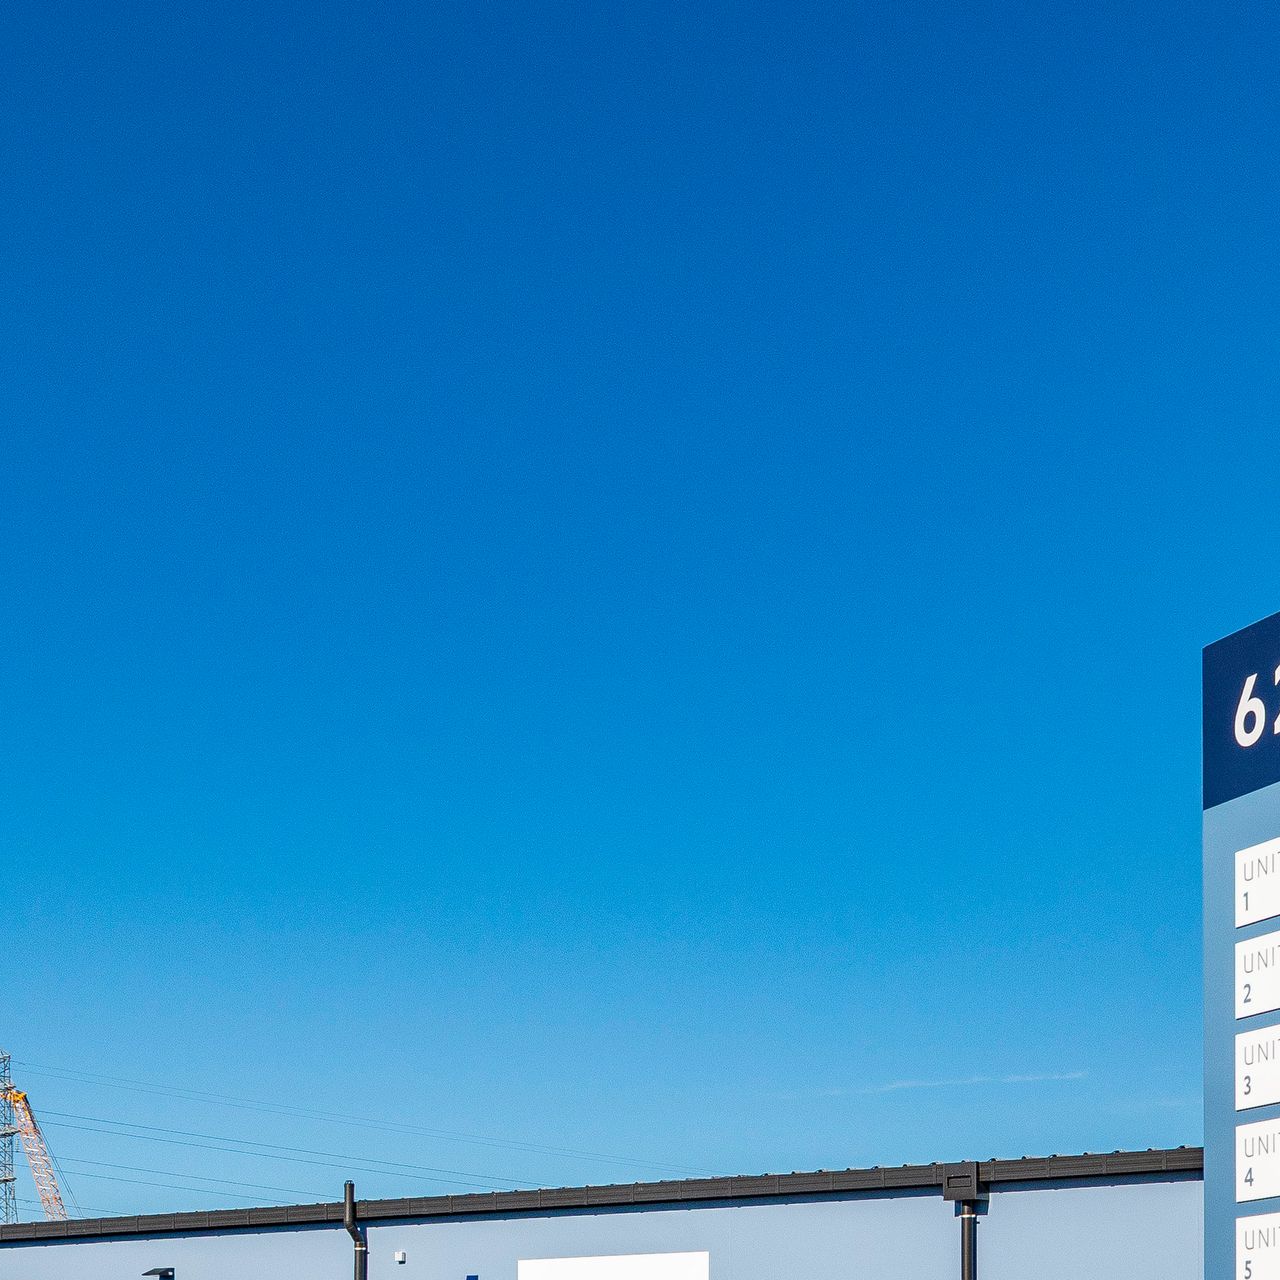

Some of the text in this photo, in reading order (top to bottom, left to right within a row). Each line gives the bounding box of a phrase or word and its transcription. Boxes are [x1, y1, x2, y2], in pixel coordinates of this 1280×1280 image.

[1242, 891, 1249, 912] 1
[1242, 983, 1252, 1004] 2
[1243, 1074, 1252, 1096] 3
[1243, 1167, 1255, 1188] 4
[1243, 1259, 1253, 1280] 5
